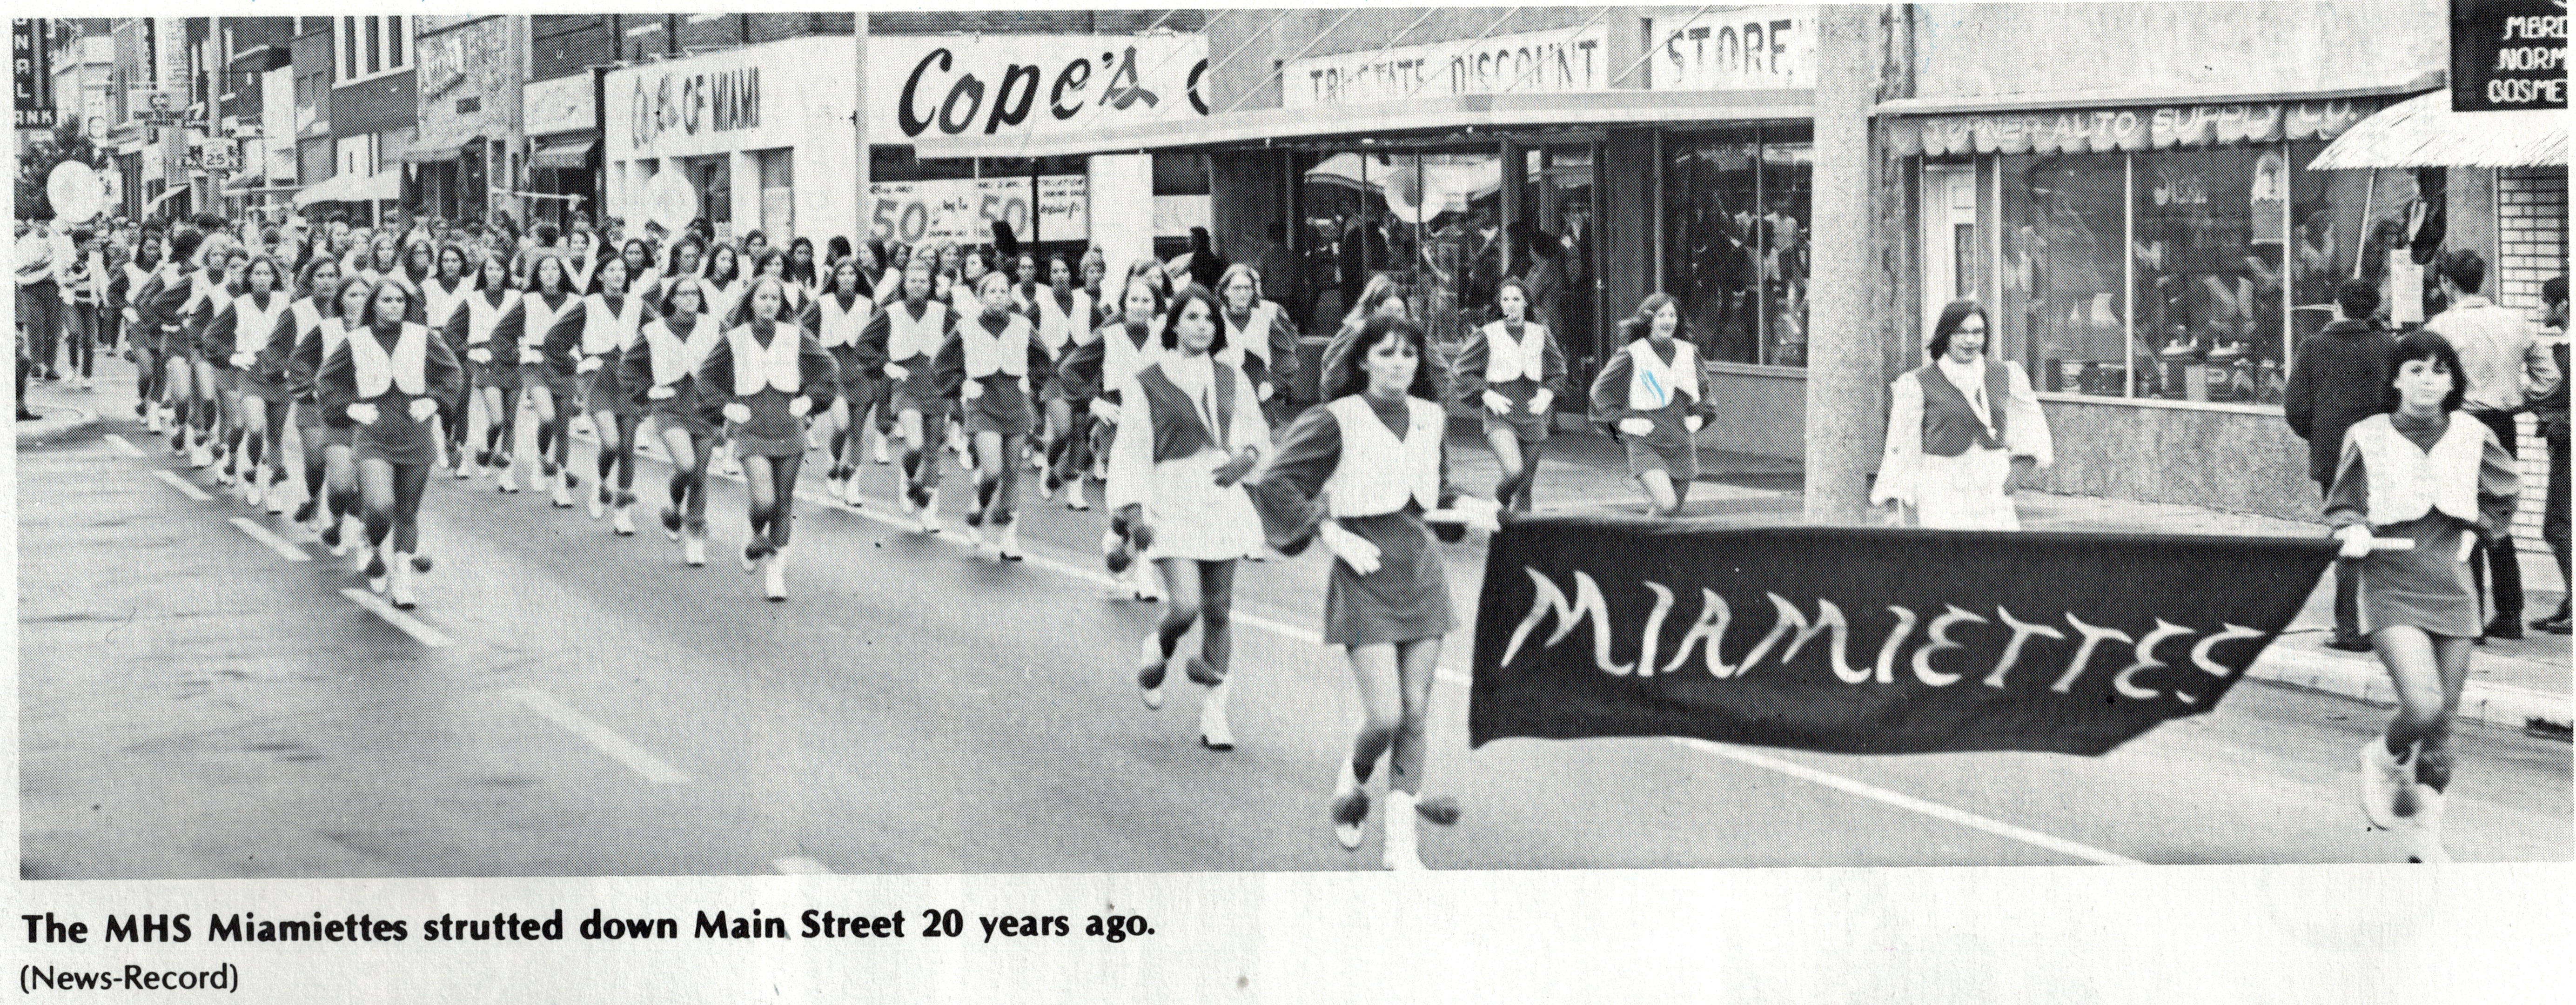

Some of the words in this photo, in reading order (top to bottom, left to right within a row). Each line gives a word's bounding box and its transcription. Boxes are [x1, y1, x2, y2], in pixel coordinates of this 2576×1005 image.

[683, 74, 705, 136] OF
[711, 66, 760, 132] MIAMI
[899, 47, 1159, 137] Cope's
[2051, 112, 2137, 141] AUTO
[206, 154, 225, 166] 25
[873, 198, 927, 243] 50
[1500, 565, 2268, 704] MIAMIETTES
